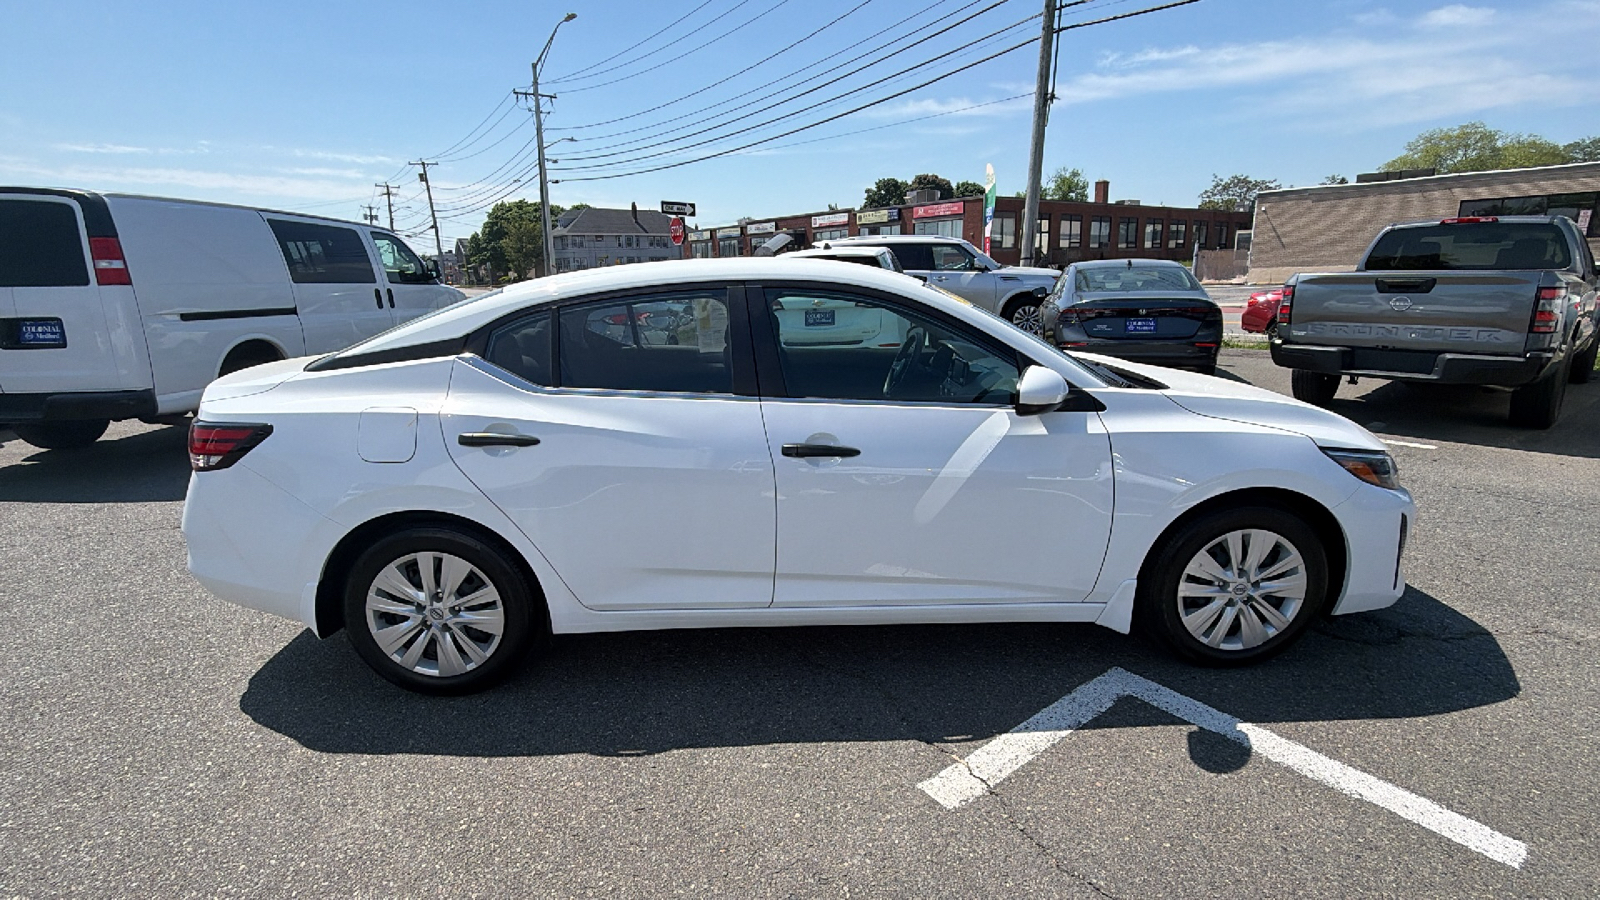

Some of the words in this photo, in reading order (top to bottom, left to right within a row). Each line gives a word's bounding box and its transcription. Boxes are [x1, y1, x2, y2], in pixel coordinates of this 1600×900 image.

[671, 225, 684, 236] STOP
[22, 325, 61, 333] COLONIAL
[1306, 322, 1502, 342] FRONTIER
